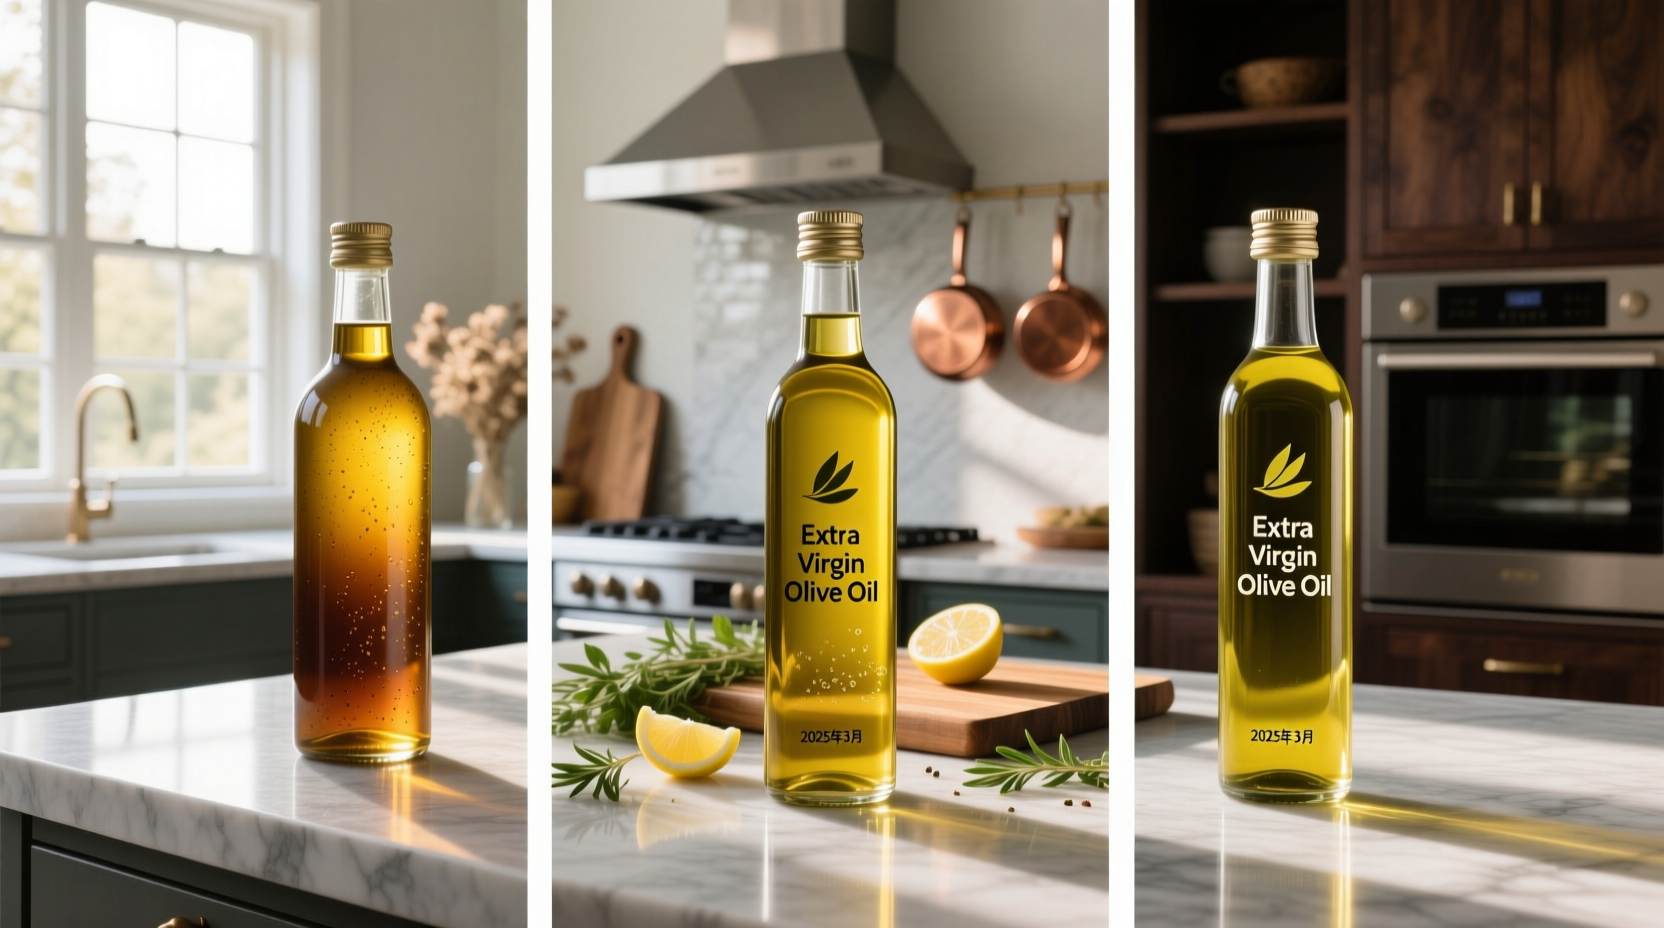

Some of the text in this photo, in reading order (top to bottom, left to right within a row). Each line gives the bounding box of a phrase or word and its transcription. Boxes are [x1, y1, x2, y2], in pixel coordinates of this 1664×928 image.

[801, 524, 860, 545] Extra
[1252, 515, 1313, 538] Extra
[798, 552, 864, 579] Virgin
[1248, 544, 1317, 573] Virgin
[784, 581, 878, 602] Olive Oil
[1237, 574, 1332, 596] Olive Oil
[800, 729, 862, 745] 2025年3月
[1250, 728, 1314, 745] 2025年3月
